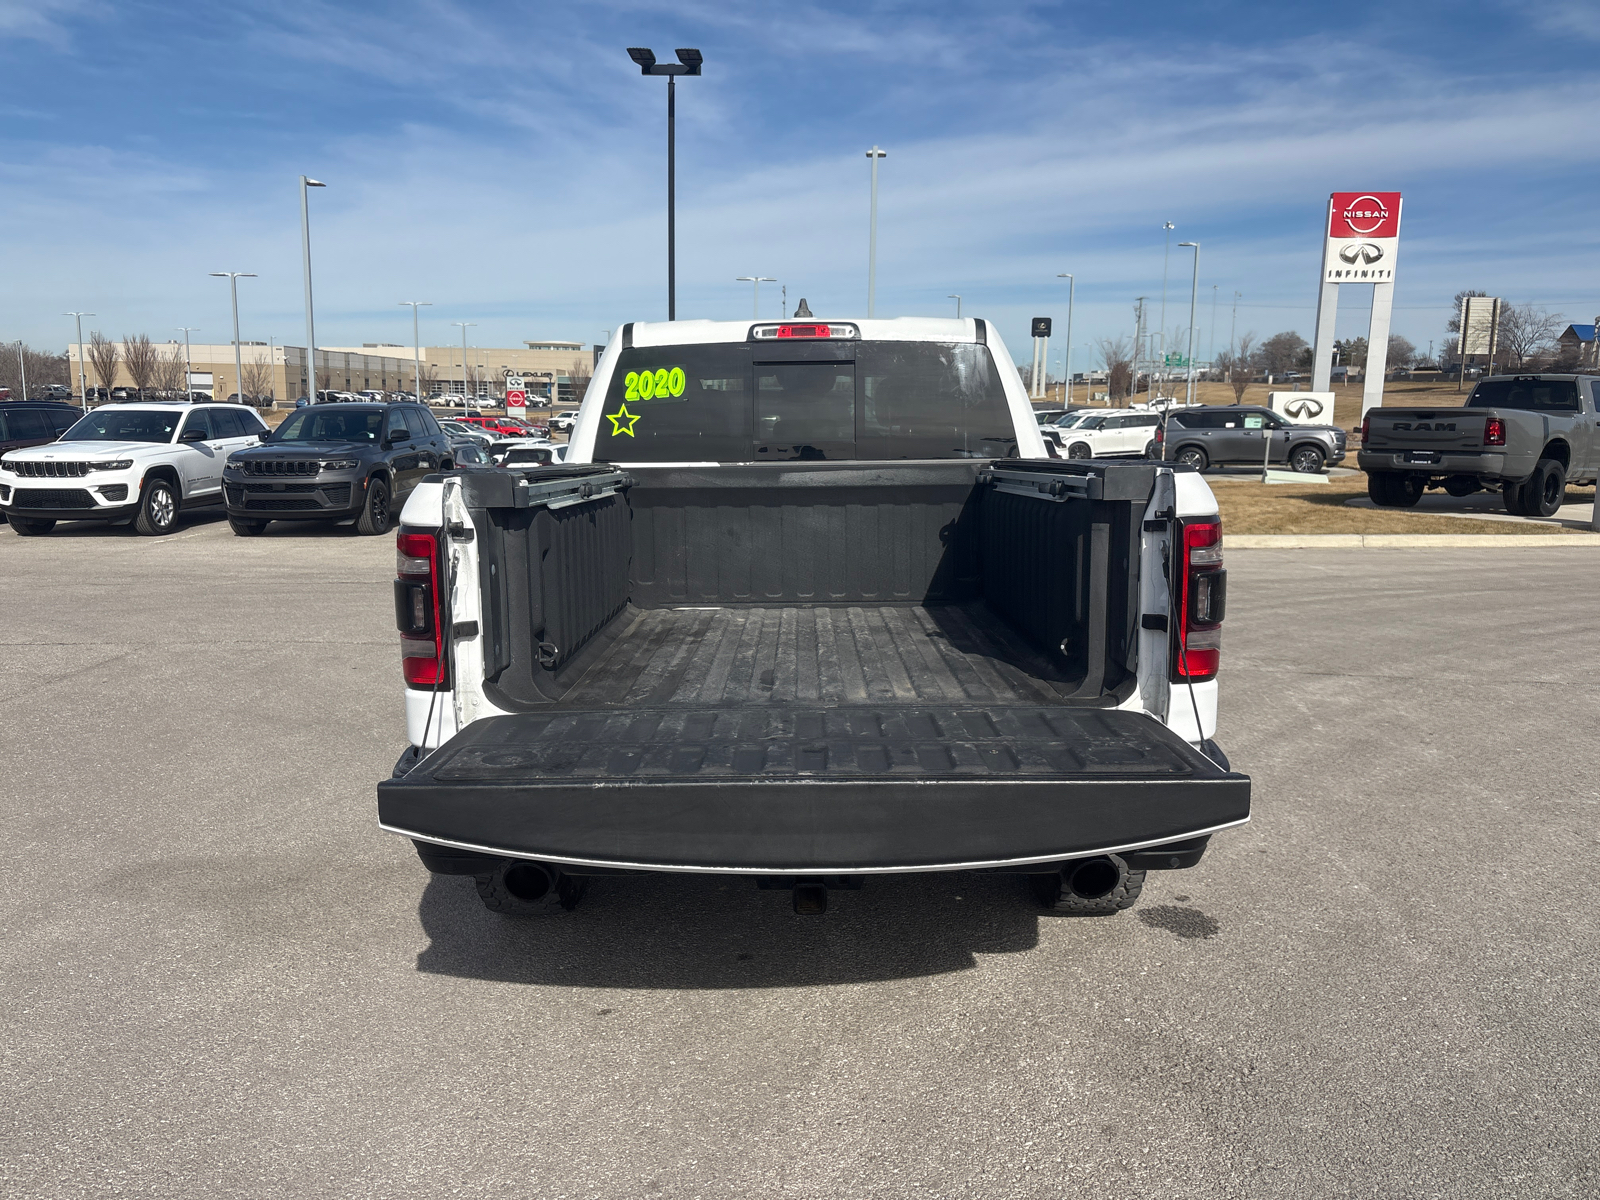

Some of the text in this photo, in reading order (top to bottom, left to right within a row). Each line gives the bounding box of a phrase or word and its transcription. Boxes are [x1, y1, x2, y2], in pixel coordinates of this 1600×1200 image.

[1343, 210, 1389, 218] NISSAN
[1328, 269, 1392, 278] INFINITI
[624, 366, 686, 402] 2020
[1392, 422, 1457, 432] RAM
